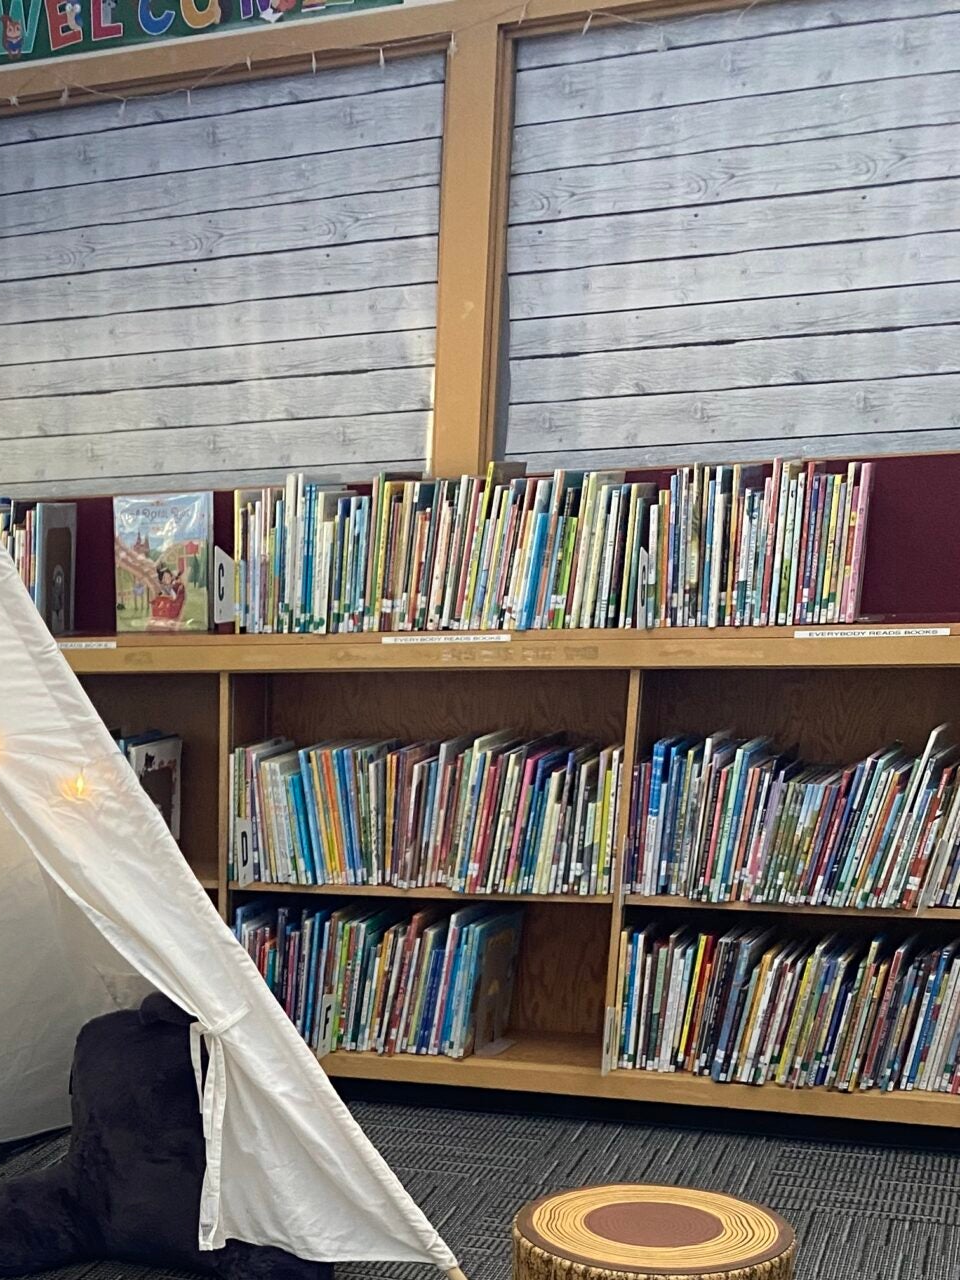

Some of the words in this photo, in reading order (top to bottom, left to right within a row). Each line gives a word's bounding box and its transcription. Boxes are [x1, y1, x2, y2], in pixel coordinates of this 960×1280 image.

[218, 562, 225, 602] C
[241, 831, 248, 867] D
[323, 1004, 331, 1040] F
